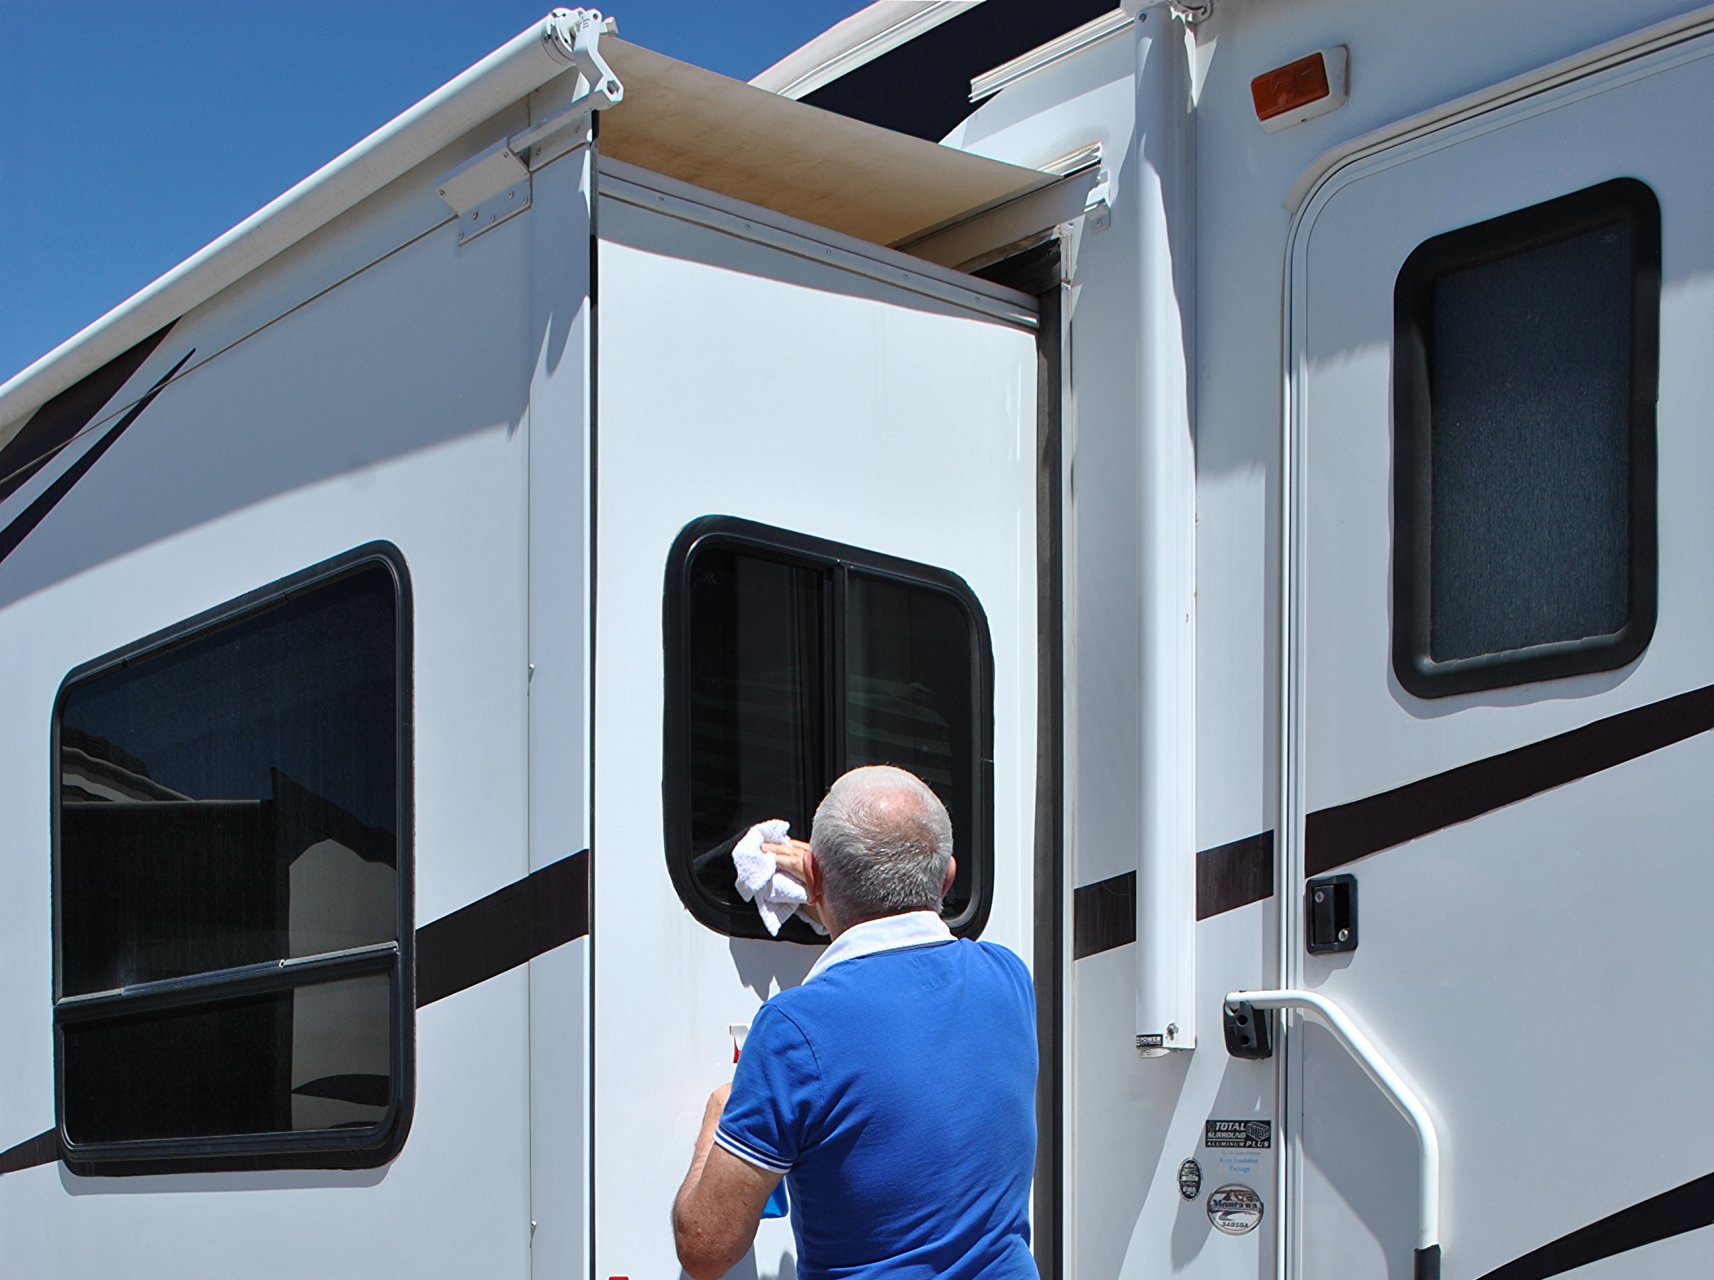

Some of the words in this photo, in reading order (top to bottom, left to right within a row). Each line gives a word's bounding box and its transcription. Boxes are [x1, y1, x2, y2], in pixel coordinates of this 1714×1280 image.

[1215, 1122, 1246, 1131] TOTAL
[1207, 1131, 1246, 1139] SURROUND
[1212, 1199, 1258, 1209] Montana
